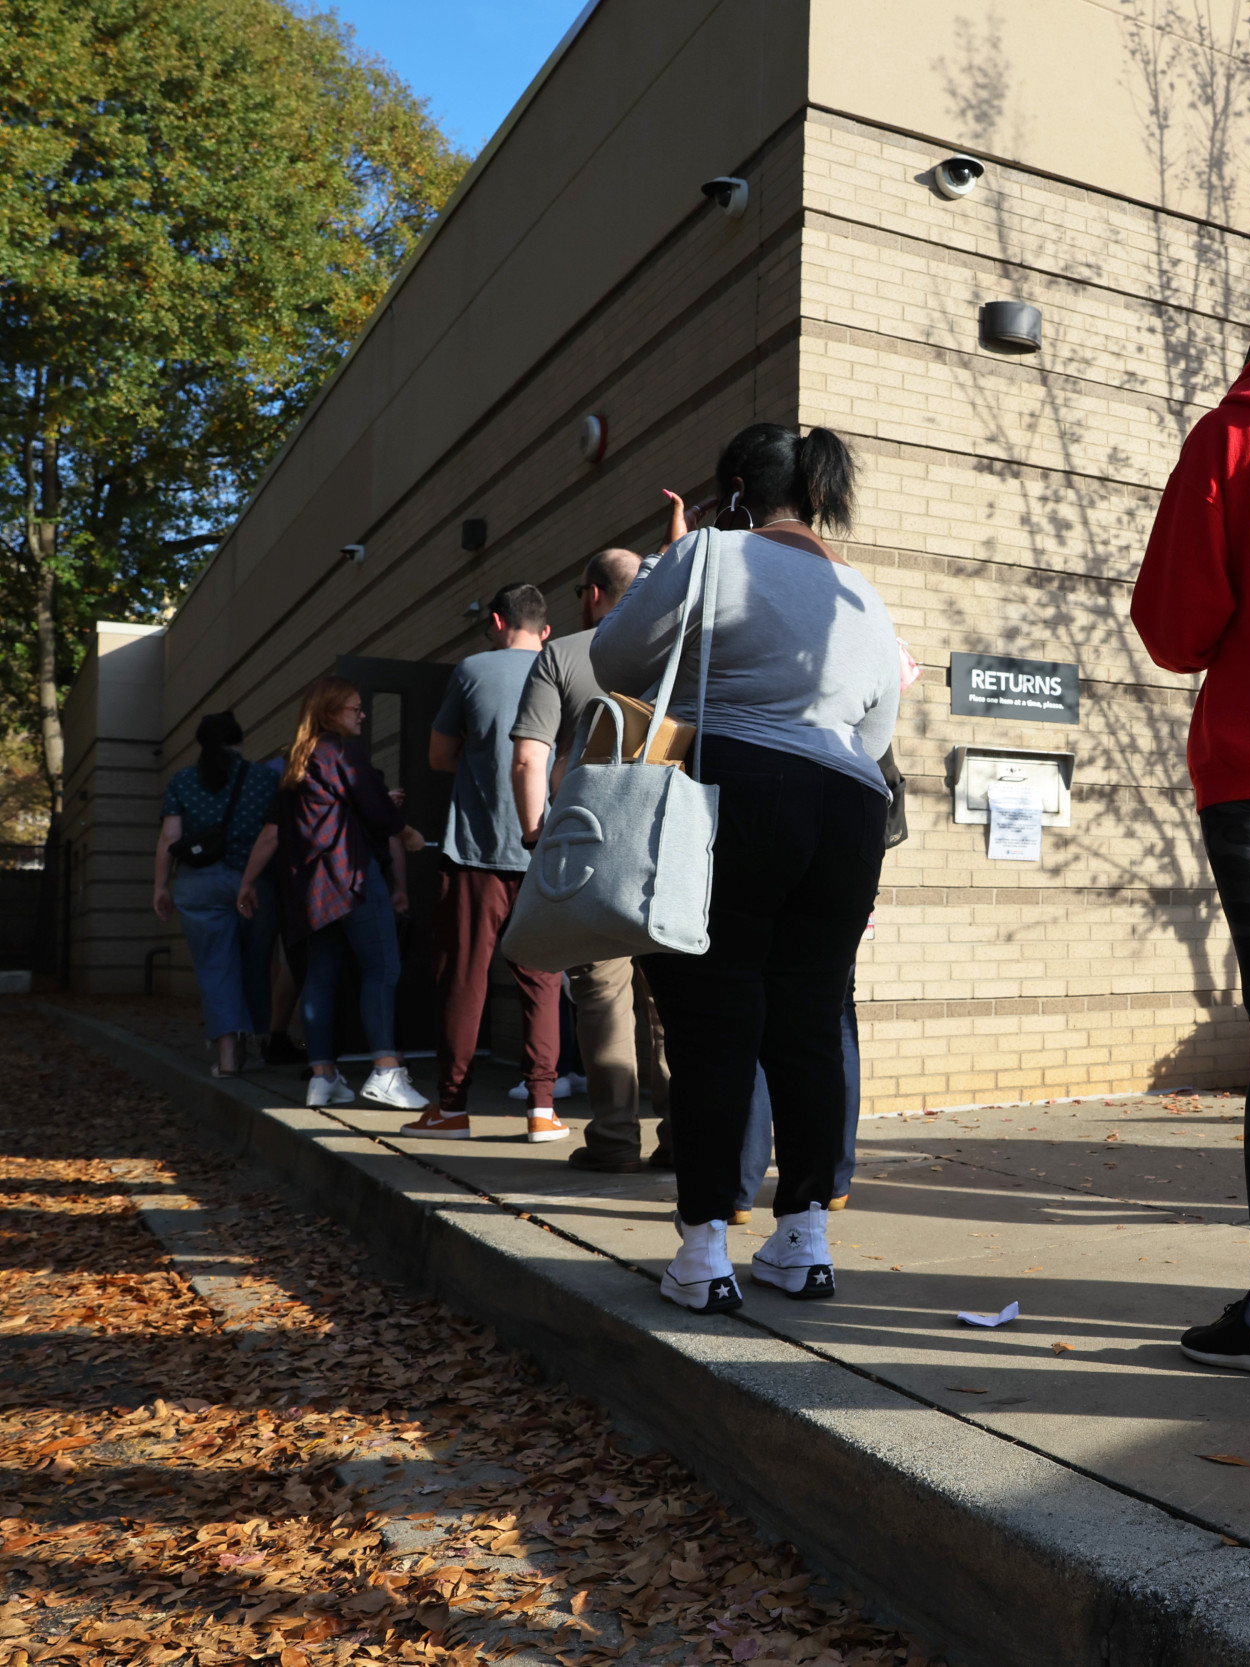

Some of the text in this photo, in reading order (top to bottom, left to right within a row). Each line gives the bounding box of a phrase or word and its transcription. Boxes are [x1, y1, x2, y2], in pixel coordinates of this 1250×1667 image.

[972, 669, 1062, 696] RETURNS
[969, 694, 985, 703] Place
[999, 696, 1013, 705] item
[1013, 698, 1021, 706] at
